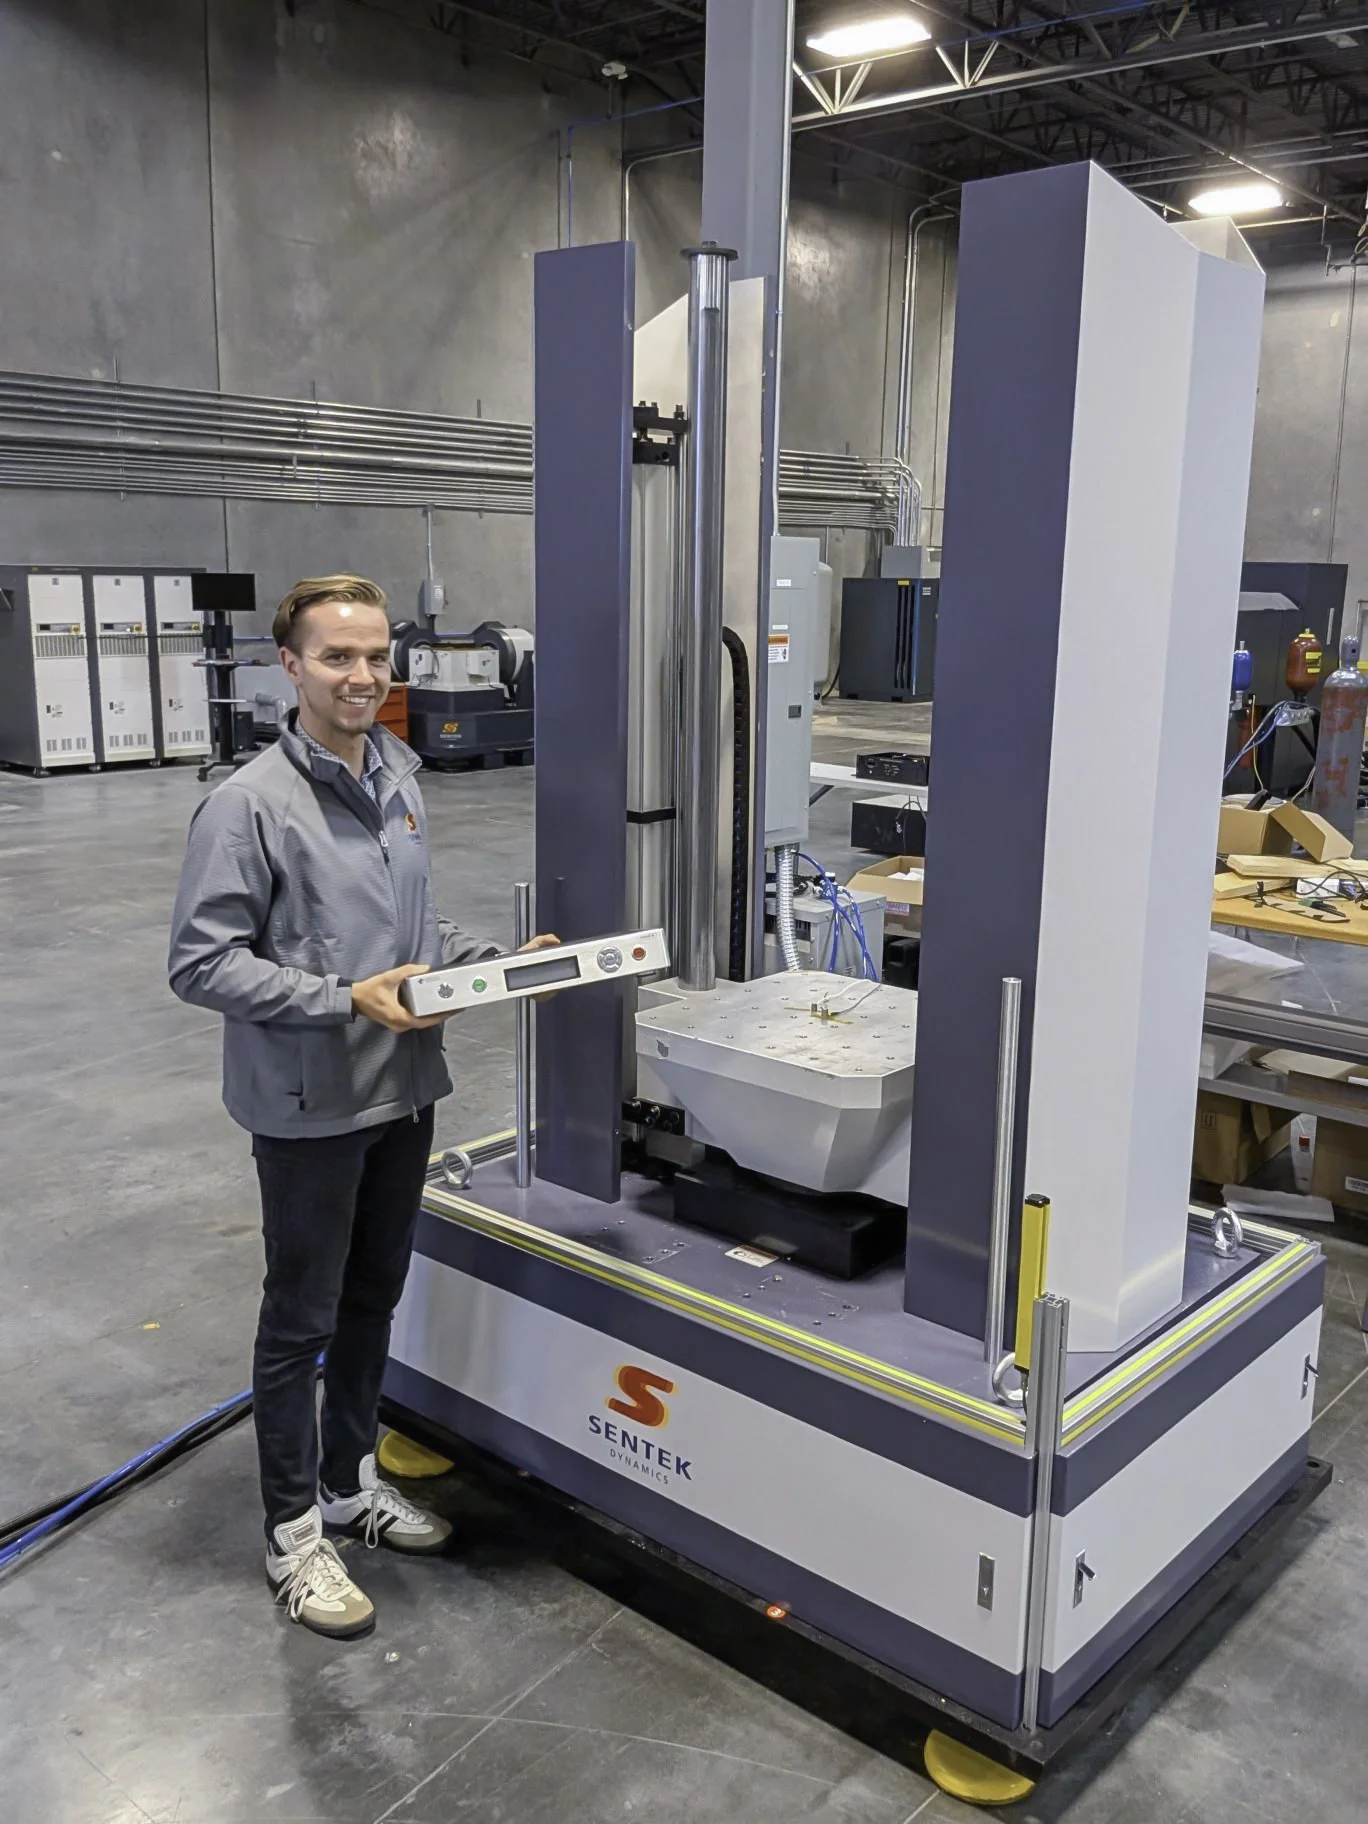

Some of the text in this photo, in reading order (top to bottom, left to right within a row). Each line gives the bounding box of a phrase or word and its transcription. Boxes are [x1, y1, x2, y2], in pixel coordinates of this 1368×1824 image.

[605, 1363, 678, 1429] S
[588, 1414, 693, 1481] SENTEK
[609, 1448, 669, 1485] DYNAMICS
